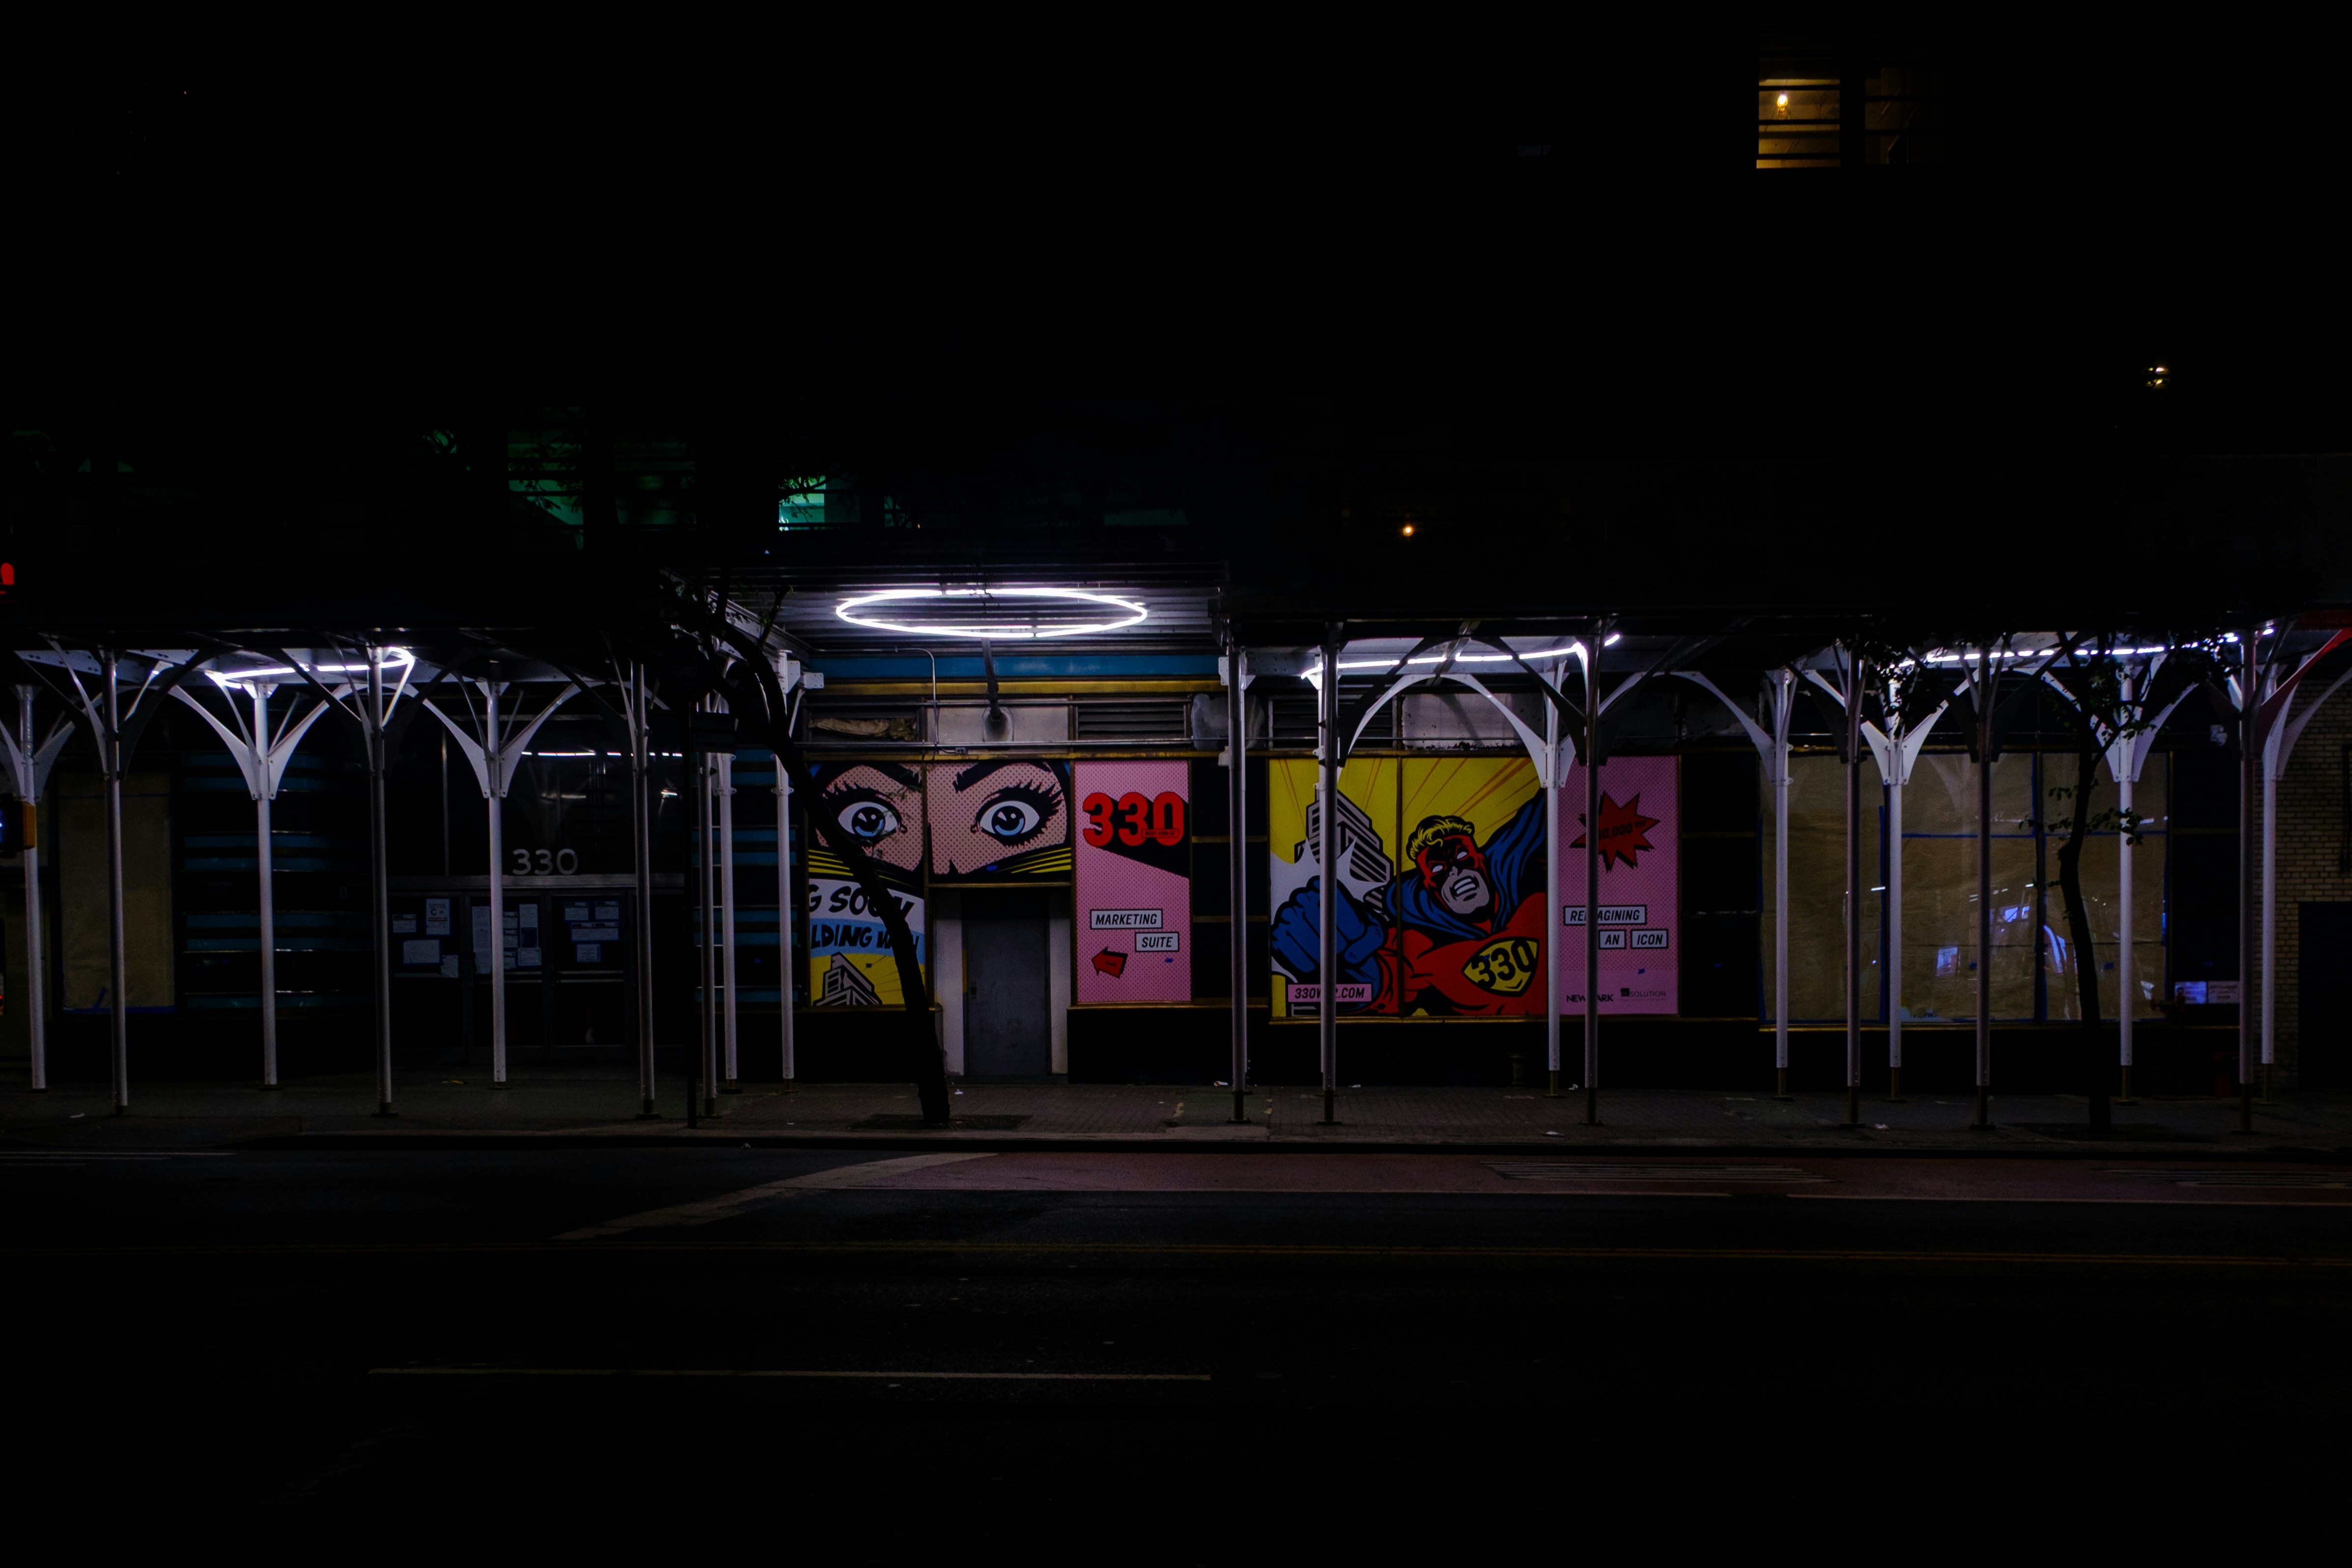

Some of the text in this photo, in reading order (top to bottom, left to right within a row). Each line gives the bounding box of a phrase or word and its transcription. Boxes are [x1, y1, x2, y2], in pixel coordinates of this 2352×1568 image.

[1083, 791, 1185, 846] 330
[512, 848, 579, 876] 330
[1095, 913, 1157, 925] MARKETING
[1570, 910, 1640, 921] REAGINING
[1142, 936, 1173, 948] SUITE
[1605, 934, 1663, 945] AN ICON
[1471, 939, 1534, 989] 330
